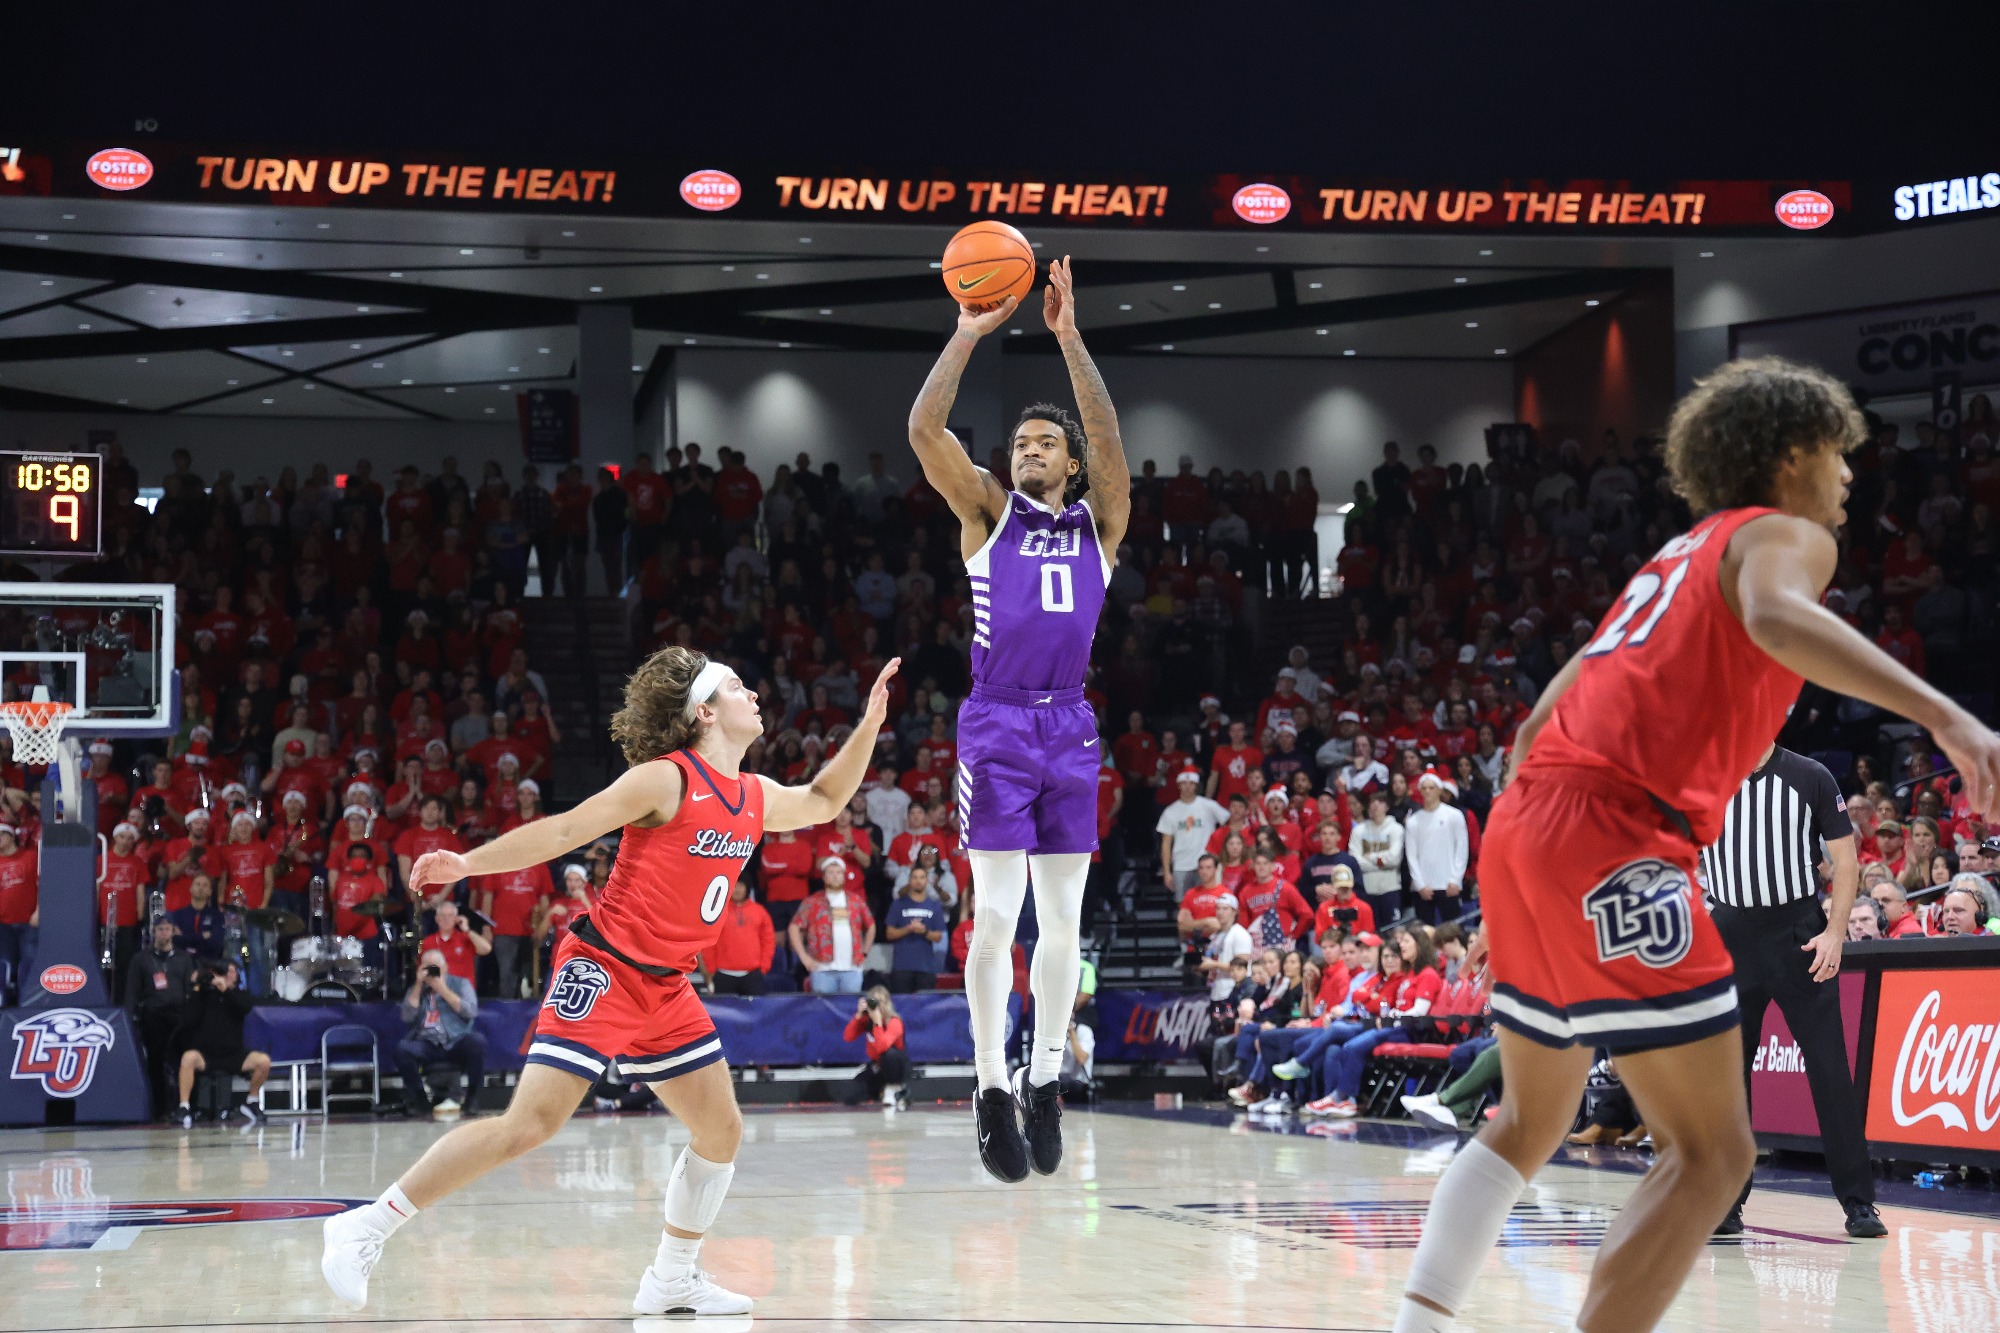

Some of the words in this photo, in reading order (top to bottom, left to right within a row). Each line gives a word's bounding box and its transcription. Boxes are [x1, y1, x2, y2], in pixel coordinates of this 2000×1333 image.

[91, 161, 147, 174] FOSTER
[197, 156, 318, 192] TURN
[328, 161, 390, 195] UP
[402, 164, 486, 198] THE
[493, 168, 616, 202] HEAT!
[685, 182, 736, 195] FOSTER
[775, 176, 889, 210] TURN
[898, 181, 956, 212] UP
[966, 182, 1045, 214] THE
[1051, 184, 1168, 217] HEAT!
[1237, 196, 1286, 208] FOSTER
[1319, 188, 1428, 221] TURN
[1436, 191, 1494, 222] UP
[1503, 192, 1583, 224] THE
[1588, 193, 1706, 225] HEAT!
[1780, 202, 1829, 214] FOSTER
[1894, 172, 2000, 221] STEALS
[1856, 323, 2000, 375] CONC
[18, 463, 90, 493] 10:58
[50, 494, 78, 541] 9
[1019, 527, 1081, 558] GCU
[1041, 563, 1074, 612] 0
[1583, 556, 1691, 659] 21
[688, 829, 755, 872] Liberty
[700, 875, 729, 925] 0
[1583, 893, 1693, 968] LU
[44, 974, 82, 983] FOSTER
[544, 970, 602, 1021] LU
[11, 1024, 100, 1098] LU
[1767, 1034, 1801, 1073] Bank
